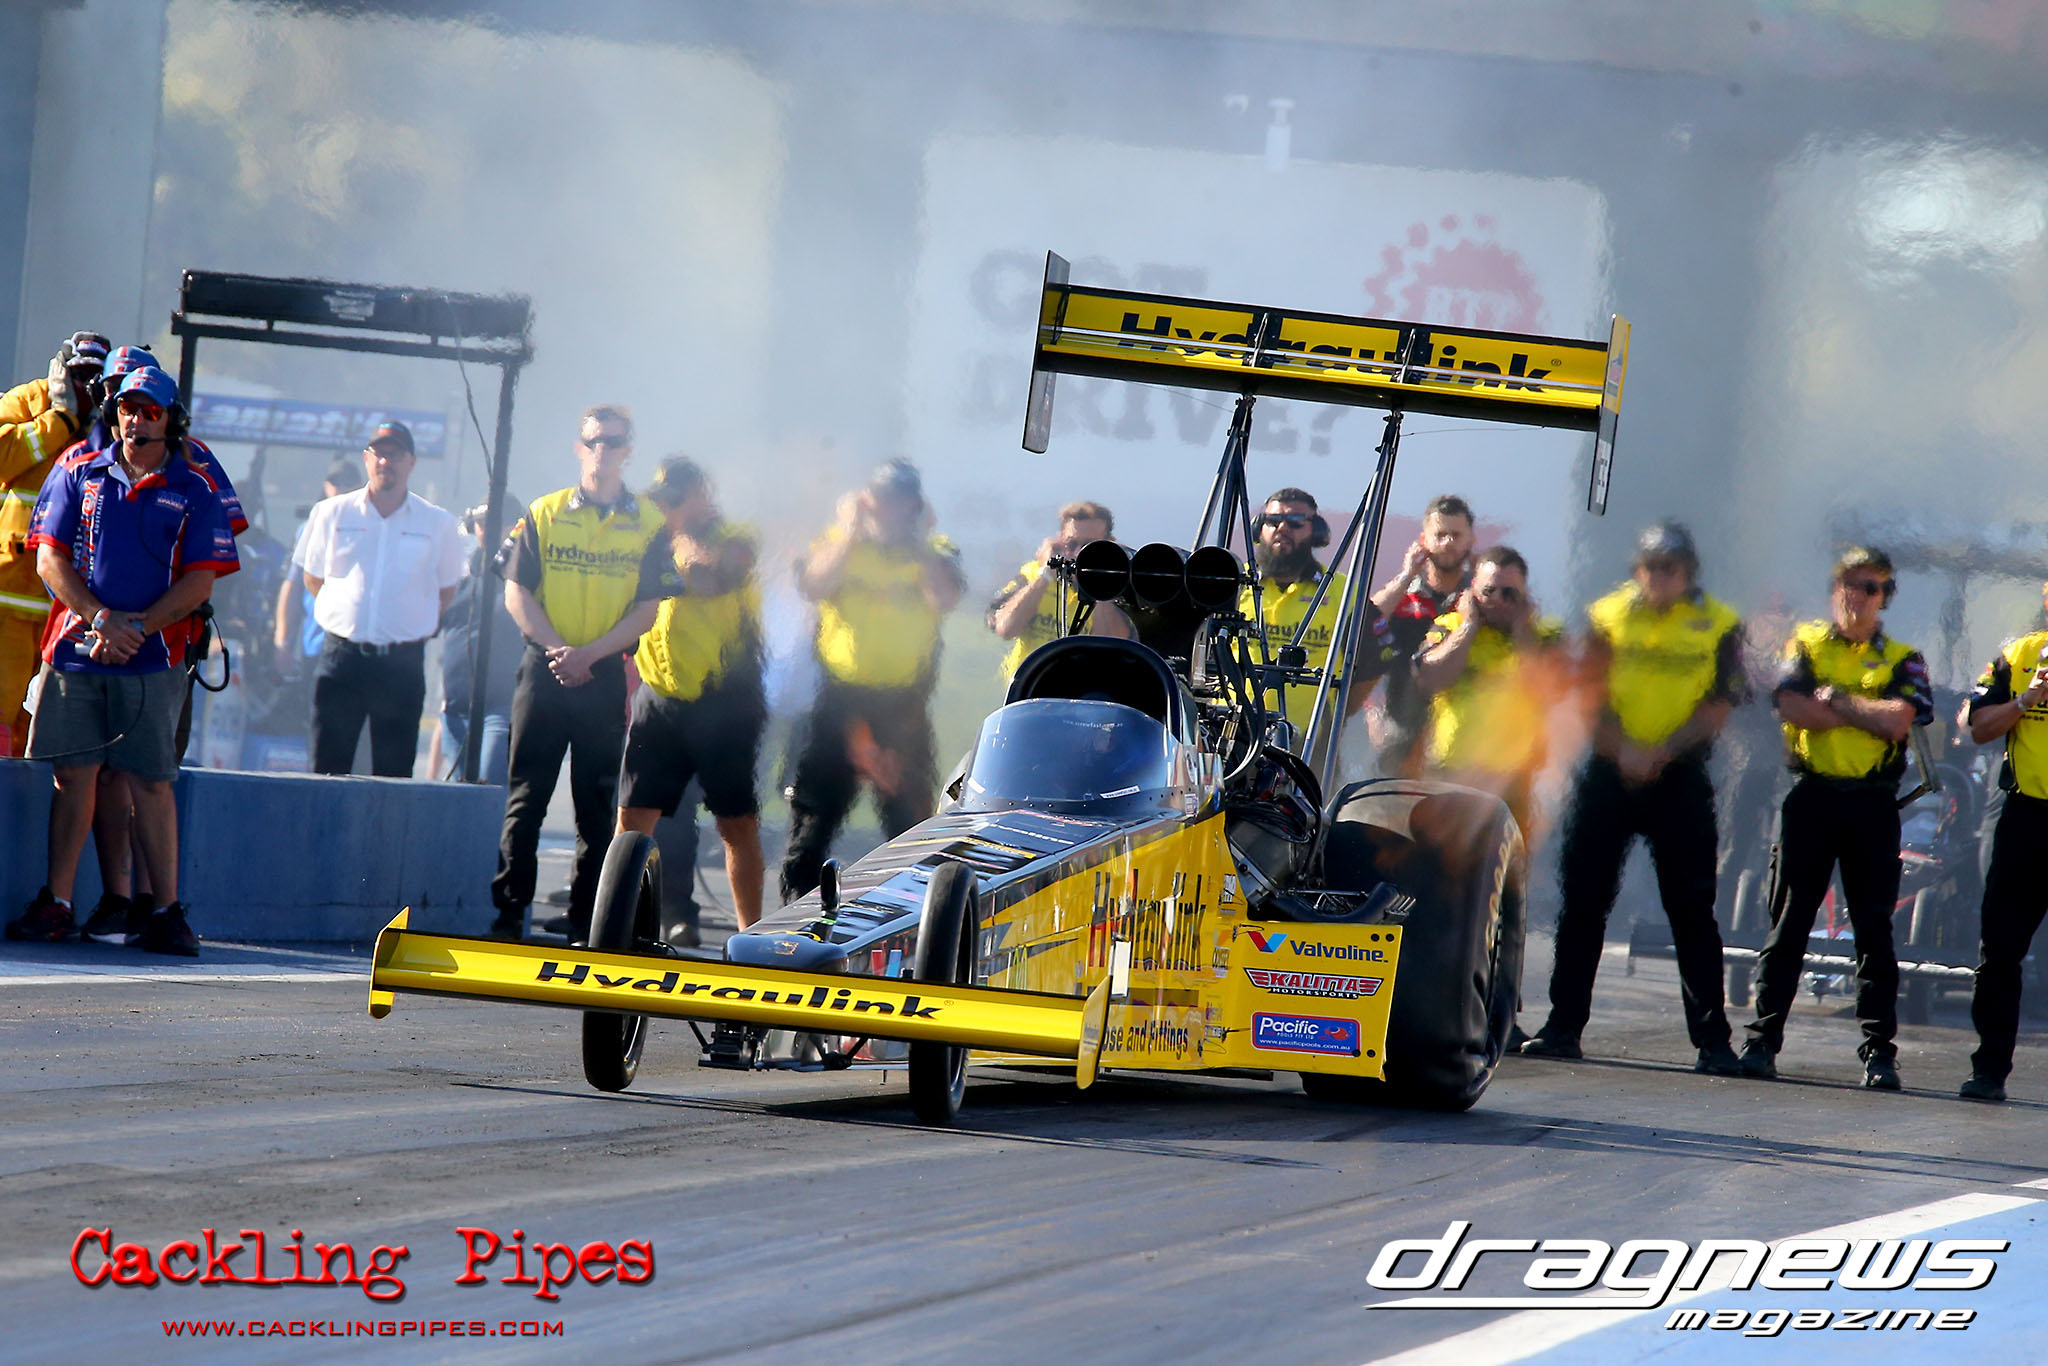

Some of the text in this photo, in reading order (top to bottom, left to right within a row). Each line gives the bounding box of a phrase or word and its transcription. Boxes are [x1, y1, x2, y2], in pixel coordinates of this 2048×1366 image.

[1117, 311, 1552, 393] Hydraulink
[1290, 940, 1384, 962] Valvoline
[535, 961, 943, 1020] Hydraulink
[1269, 973, 1359, 992] KALITTA
[1272, 988, 1358, 999] MOTORSPORTS
[1102, 1024, 1123, 1052] ose
[1126, 1020, 1148, 1052] and
[1259, 1017, 1319, 1036] Pacific
[1259, 1038, 1351, 1050] www.pacificpools.com.au
